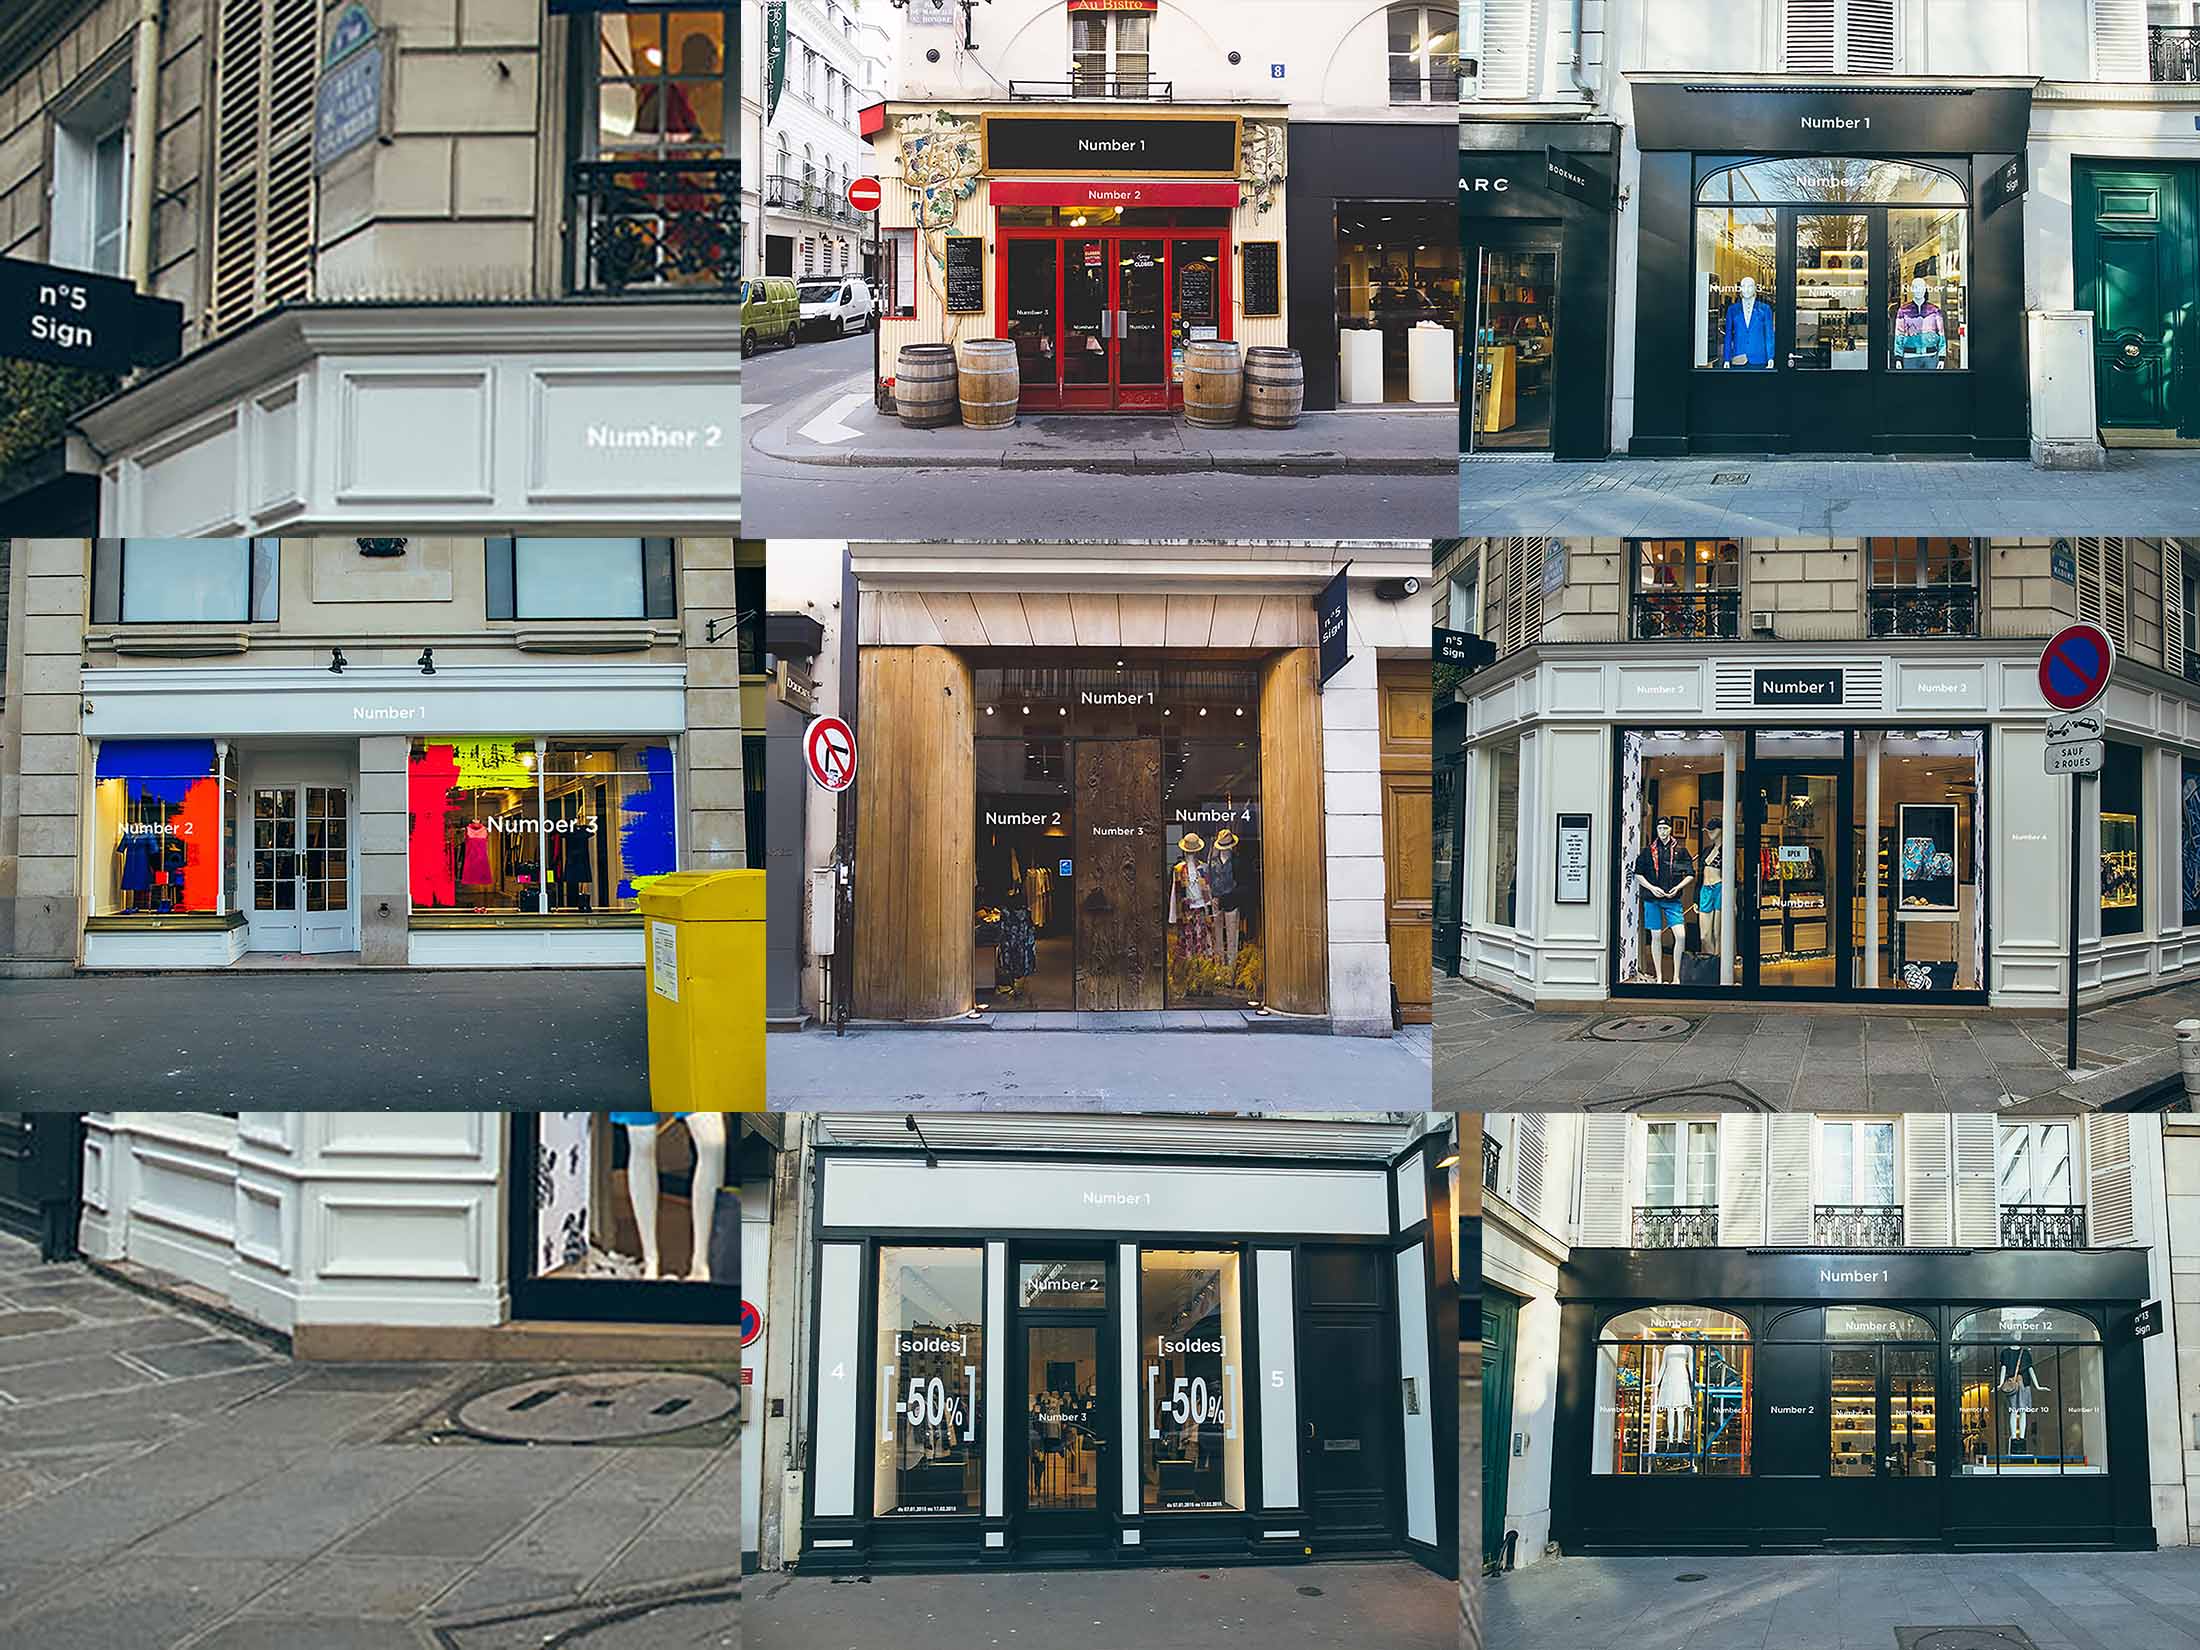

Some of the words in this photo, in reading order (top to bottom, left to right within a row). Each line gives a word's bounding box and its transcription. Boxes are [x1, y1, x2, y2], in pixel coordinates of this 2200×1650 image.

[1078, 0, 1098, 9] Au
[1103, 0, 1143, 9] Bistro
[1274, 64, 1283, 78] 8
[1801, 116, 1861, 129] Number
[1864, 117, 1871, 129] 1
[1078, 139, 1136, 151] Number
[1140, 140, 1145, 151] 1
[1458, 178, 1508, 191] ARC
[1796, 175, 1854, 187] Number
[1088, 190, 1131, 200] Number
[1135, 191, 1142, 200] 2
[1902, 284, 1945, 293] Nber
[40, 284, 87, 310] n°5
[31, 314, 92, 348] Sign
[587, 424, 698, 448] Number
[705, 424, 722, 448] 2
[1322, 618, 1344, 643] Sign
[1445, 636, 1463, 646] n°5
[1442, 646, 1465, 659] Sign
[1637, 684, 1677, 695] Number
[1763, 680, 1824, 694] Number
[1829, 681, 1835, 694] 1
[1918, 683, 1958, 693] Number
[1081, 691, 1143, 705] Number
[1147, 692, 1154, 705] 1
[353, 705, 416, 719] Number
[419, 706, 425, 719] 1
[2061, 746, 2084, 757] SAUF
[2054, 760, 2060, 769] 2
[2062, 758, 2091, 768] ROUES
[985, 812, 1046, 825] Number
[1050, 812, 1061, 825] 2
[1175, 809, 1236, 822] Number
[1240, 810, 1251, 822] 4
[118, 822, 179, 834] Number
[184, 822, 194, 835] 2
[487, 815, 579, 833] Number
[586, 815, 598, 833] 3
[1092, 827, 1134, 836] Number
[1136, 827, 1144, 836] 3
[1772, 898, 1816, 908] Number
[1818, 898, 1825, 908] 3
[1083, 1192, 1141, 1204] Number
[1144, 1192, 1151, 1206] 1
[1820, 1270, 1879, 1282] Number
[1882, 1270, 1888, 1282] 1
[1027, 1279, 1085, 1291] Number
[1089, 1279, 1100, 1291] 2
[1650, 1318, 1693, 1328] Number
[1695, 1319, 1703, 1328] 7
[1846, 1321, 1887, 1331] Number
[1889, 1321, 1897, 1331] 8
[1999, 1321, 2039, 1331] Number
[2041, 1321, 2053, 1331] 12
[831, 1361, 846, 1379] 4
[1271, 1370, 1284, 1388] 5
[1770, 1405, 1806, 1414] Number
[1808, 1406, 1815, 1414] 2
[1039, 1412, 1079, 1421] Number
[1081, 1412, 1087, 1421] 3
